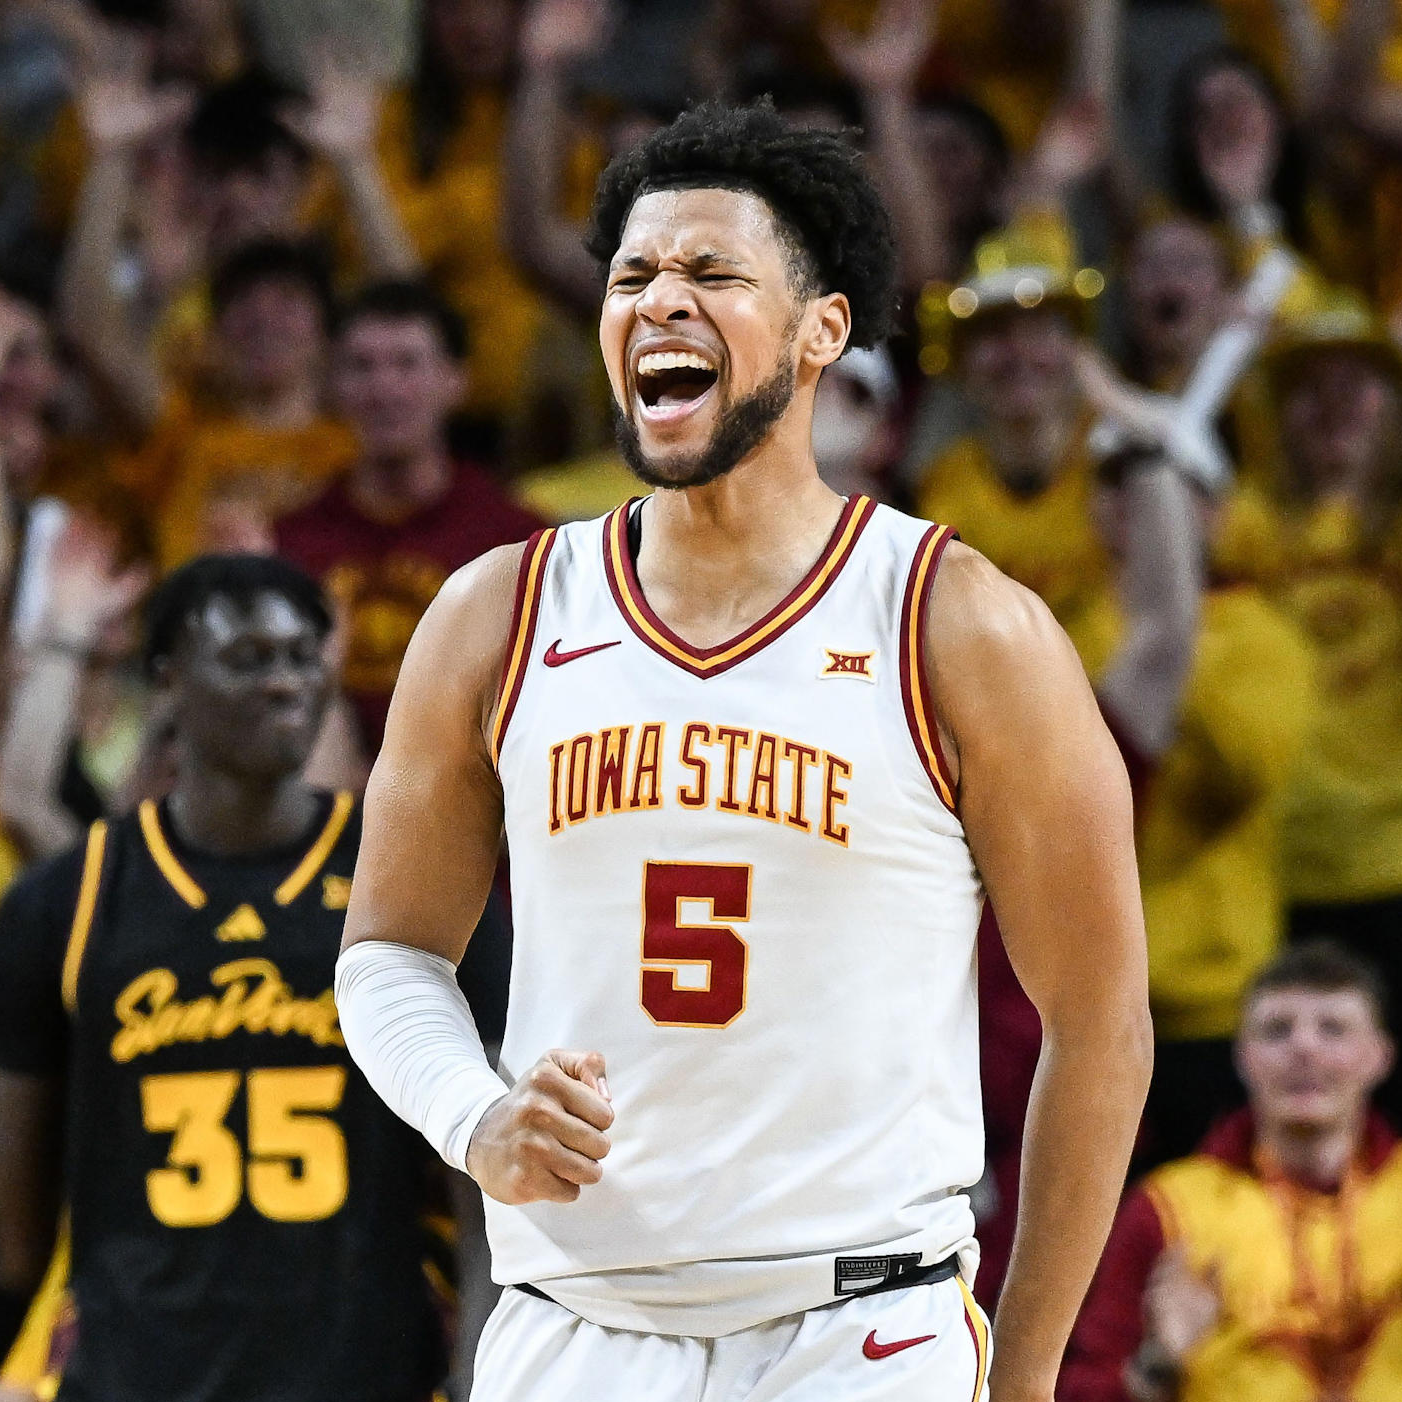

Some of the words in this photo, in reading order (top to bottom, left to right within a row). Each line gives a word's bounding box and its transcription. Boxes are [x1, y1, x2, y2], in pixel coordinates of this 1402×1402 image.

[824, 650, 873, 677] XII
[548, 721, 667, 837] IOWA
[676, 721, 853, 848] STATE
[638, 859, 754, 1030] 5
[140, 1064, 350, 1229] 35
